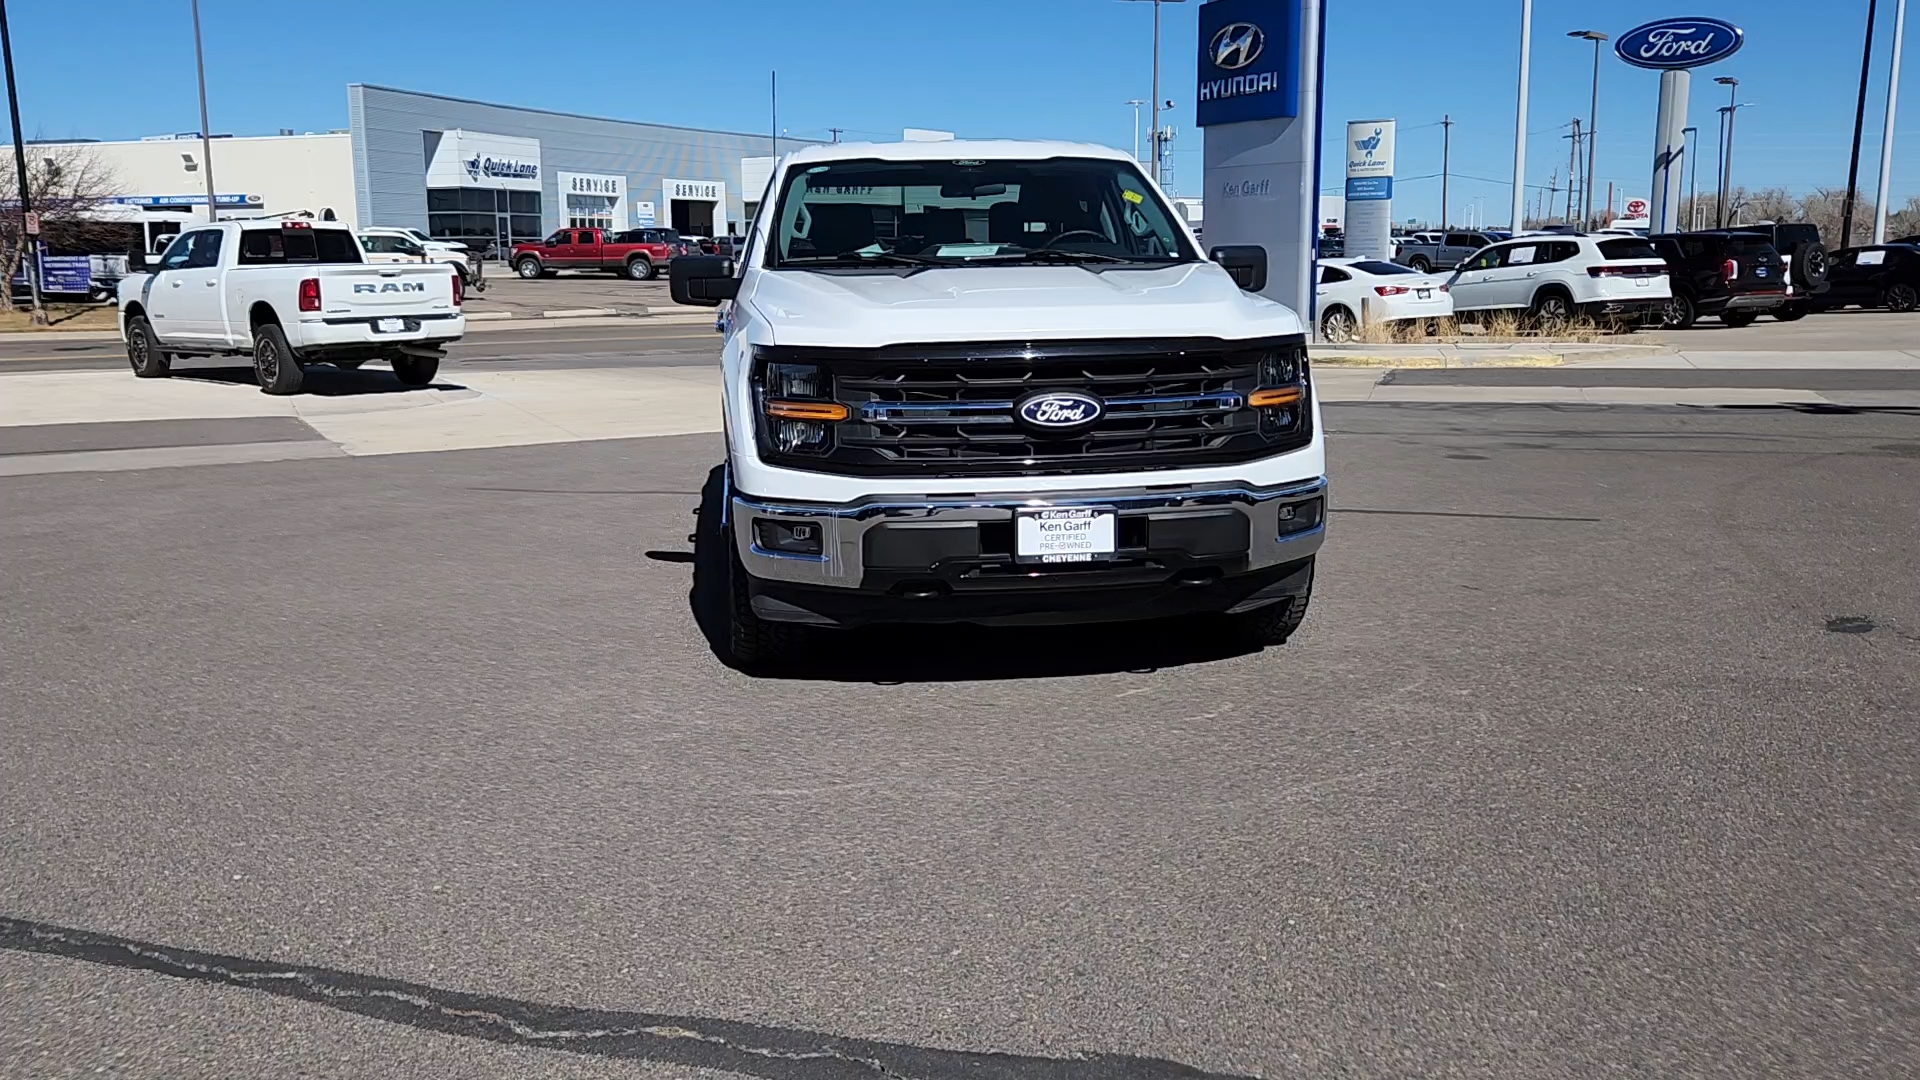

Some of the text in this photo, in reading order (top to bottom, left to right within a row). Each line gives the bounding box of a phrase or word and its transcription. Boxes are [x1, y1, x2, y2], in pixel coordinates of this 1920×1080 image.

[1640, 28, 1715, 58] Ford
[1201, 72, 1277, 101] HYUNDAI
[484, 157, 538, 174] Quick Lane
[1349, 160, 1367, 168] Quick
[572, 177, 617, 192] SERVICE
[675, 183, 716, 197] SERVICE
[1223, 179, 1270, 196] Ken Garff
[353, 282, 425, 293] RAM
[1036, 400, 1086, 421] Ford
[1050, 509, 1092, 519] Ken Garff
[1040, 521, 1091, 532] Ken Garff
[1044, 533, 1087, 542] CERTIFIED
[1042, 553, 1092, 563] CHEYENNE
